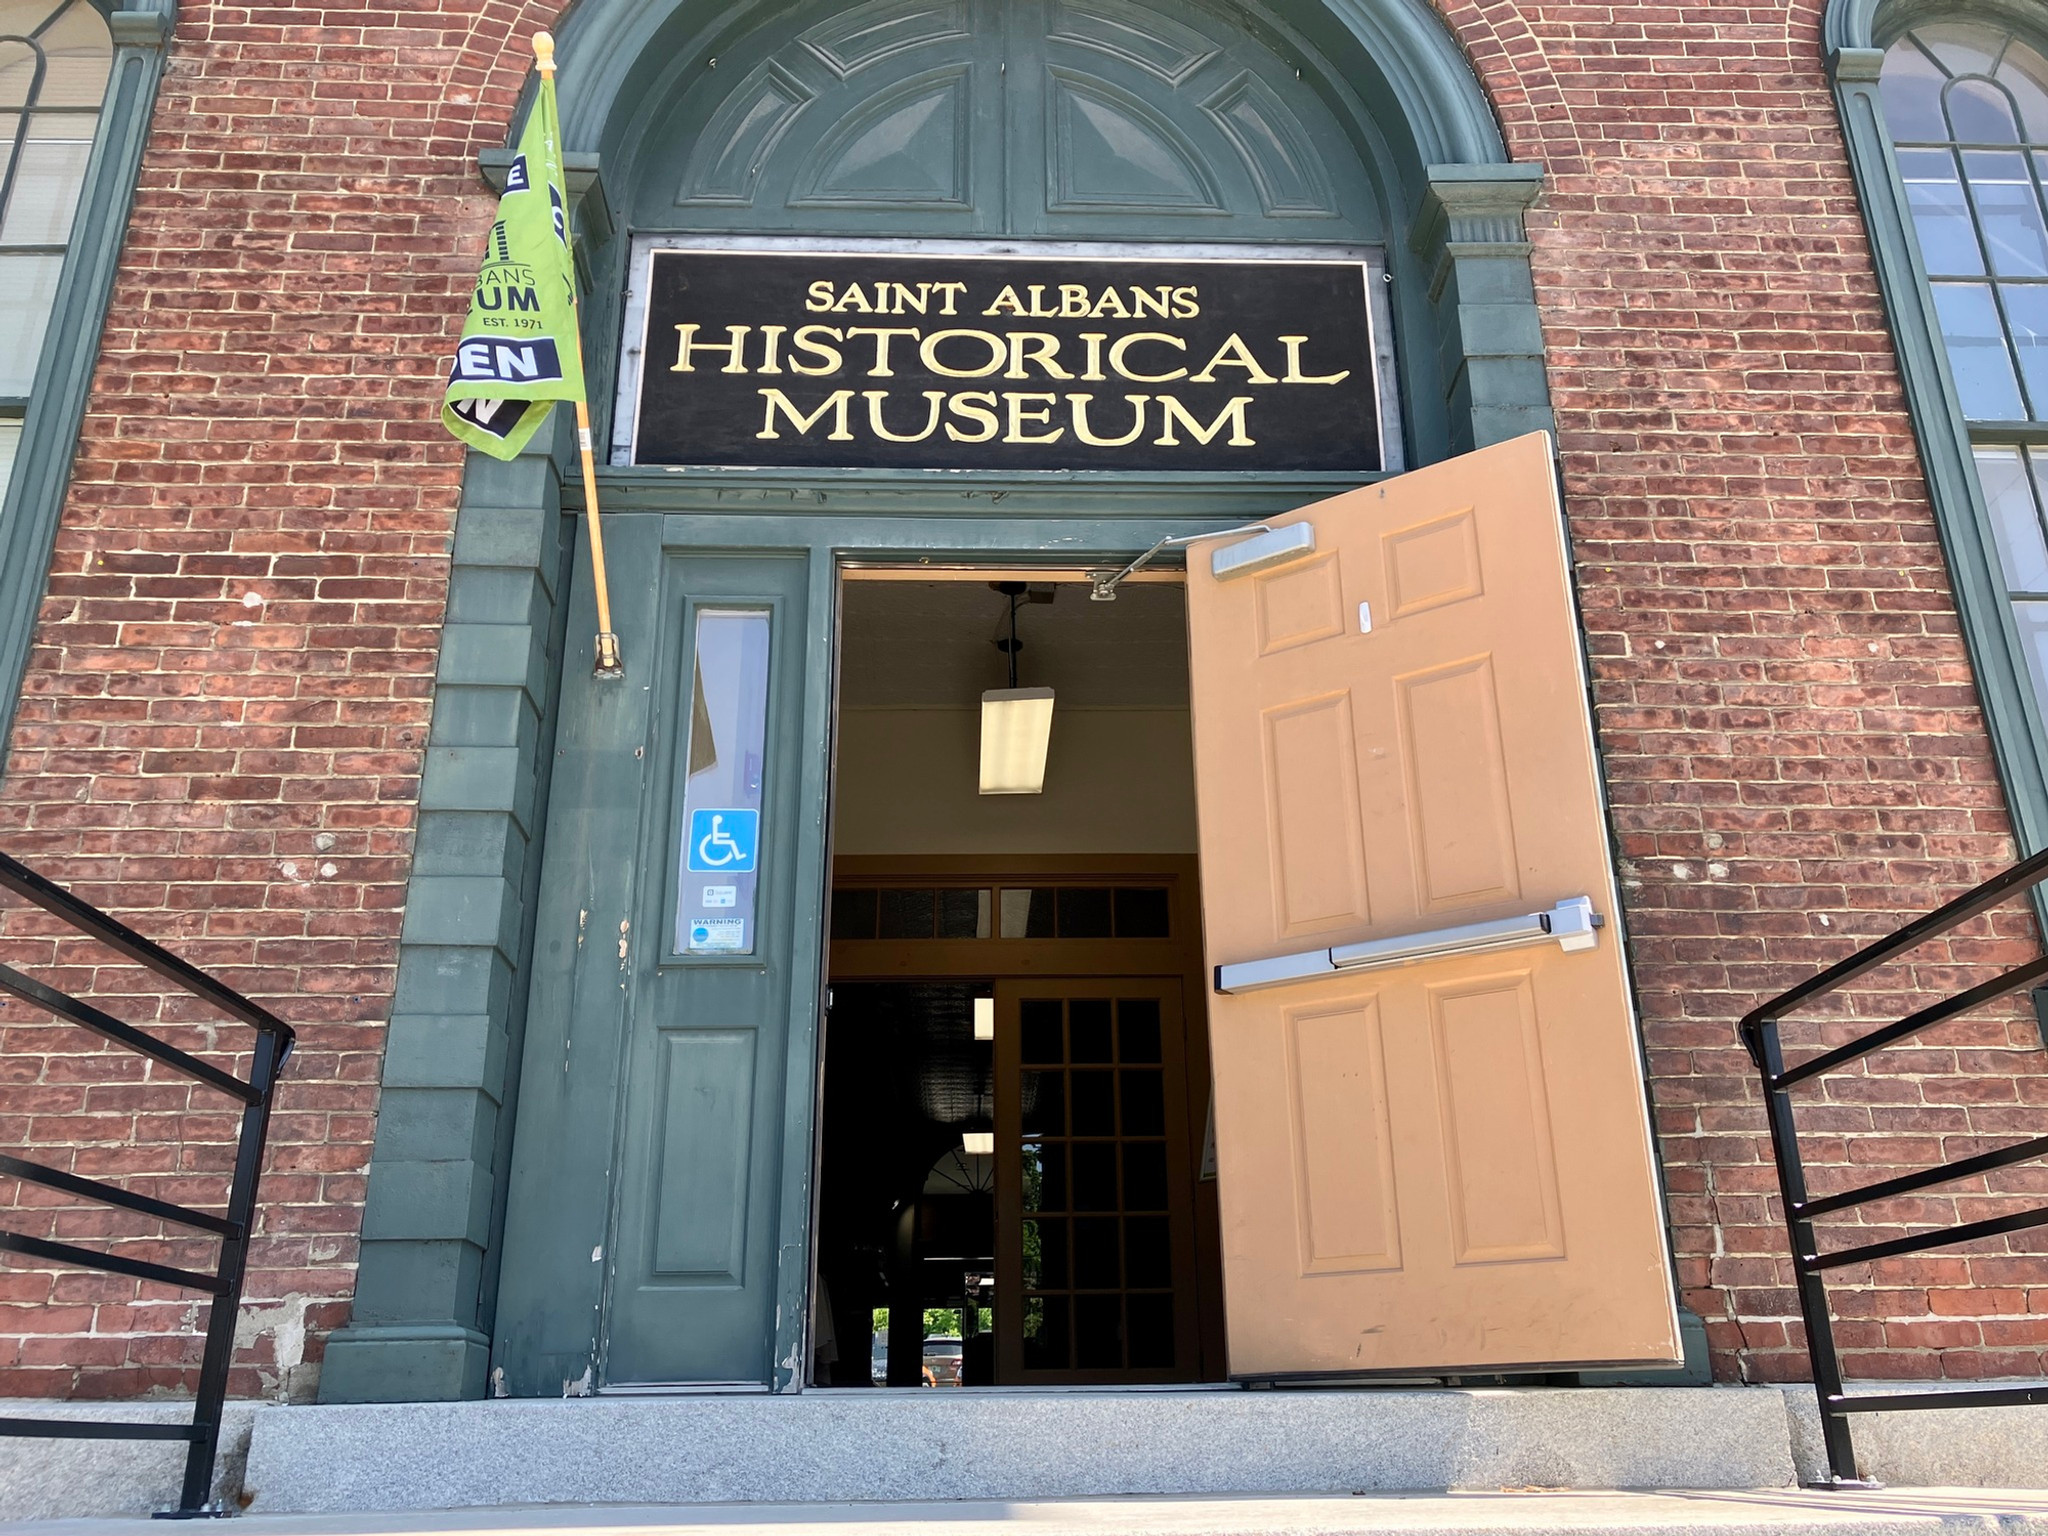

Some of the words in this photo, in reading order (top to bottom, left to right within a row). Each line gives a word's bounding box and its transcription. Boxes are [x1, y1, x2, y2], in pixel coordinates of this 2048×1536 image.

[467, 286, 541, 315] UM
[806, 280, 967, 316] SAINT
[982, 284, 1200, 319] ALBANS
[483, 318, 509, 327] EST.
[514, 319, 543, 330] 1971
[451, 343, 539, 379] EN
[670, 323, 1350, 385] HISTORICAL
[756, 388, 1256, 447] MUSEUM
